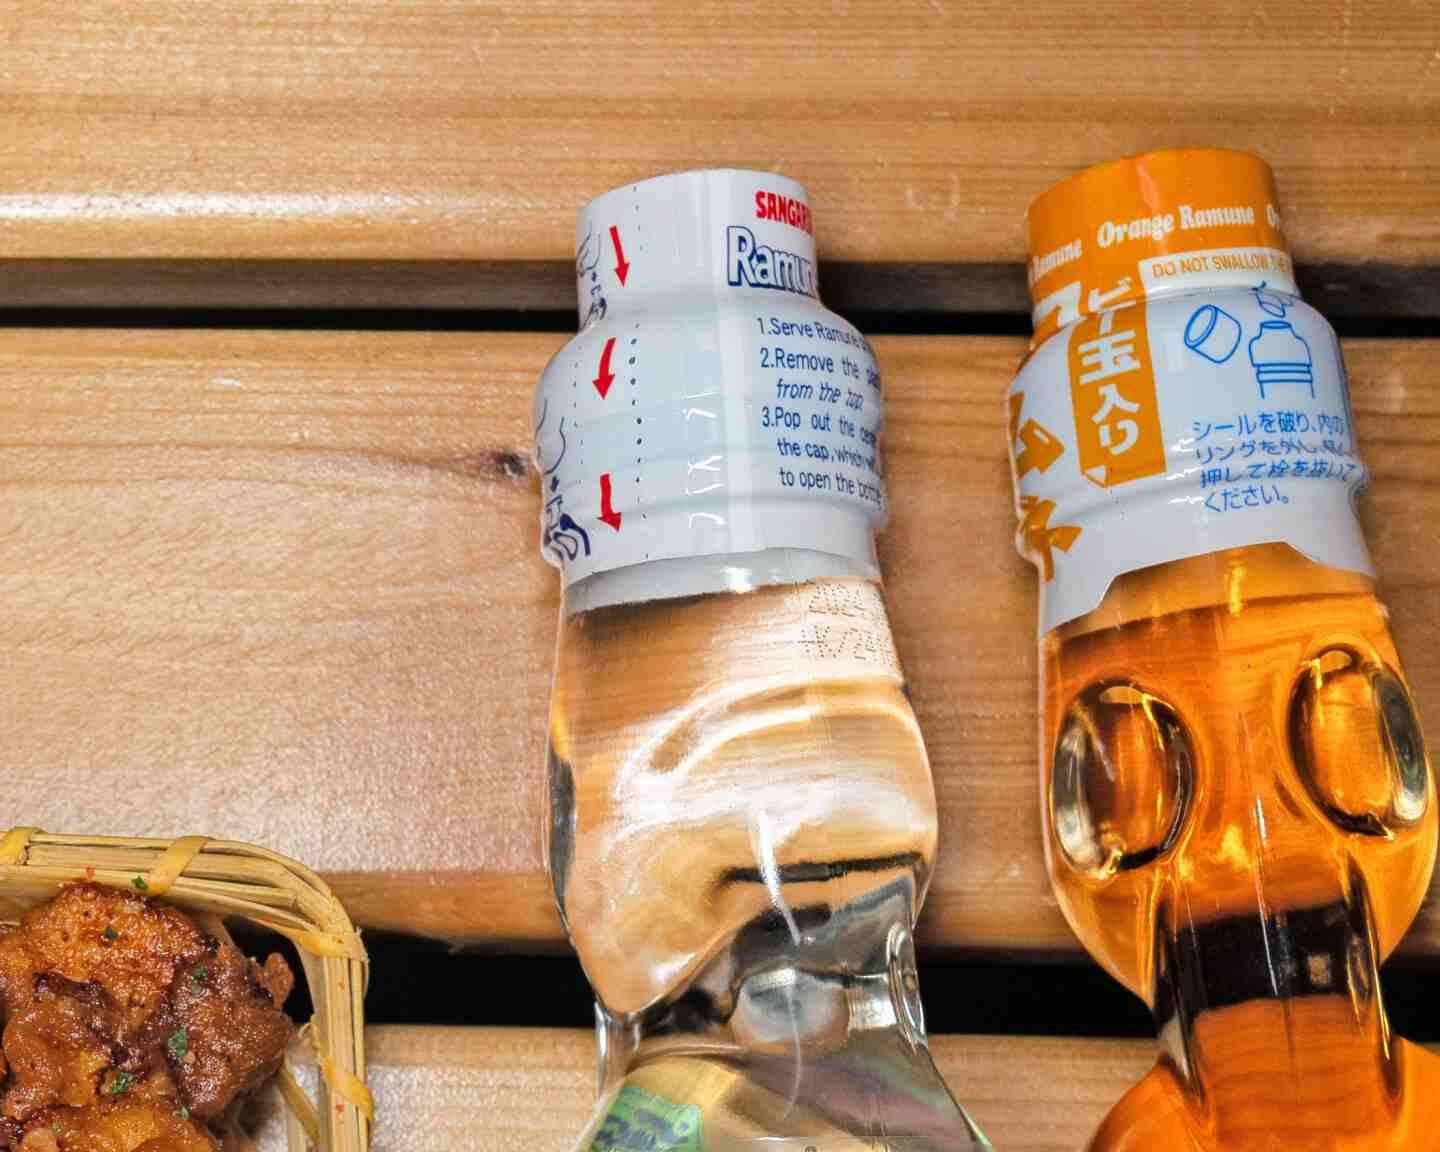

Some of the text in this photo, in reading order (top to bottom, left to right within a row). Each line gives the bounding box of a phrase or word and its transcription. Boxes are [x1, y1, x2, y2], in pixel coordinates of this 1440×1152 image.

[1097, 212, 1174, 249] Orange
[1178, 204, 1255, 230] Ramune
[1152, 262, 1176, 278] DO
[1180, 255, 1209, 273] NOT
[1078, 276, 1141, 456] ビー玉入り
[777, 378, 813, 399] from
[820, 382, 841, 404] the
[811, 412, 831, 432] out
[839, 416, 855, 438] the
[777, 437, 801, 457] the
[780, 467, 794, 487] to
[800, 471, 831, 490] open
[836, 472, 855, 494] the
